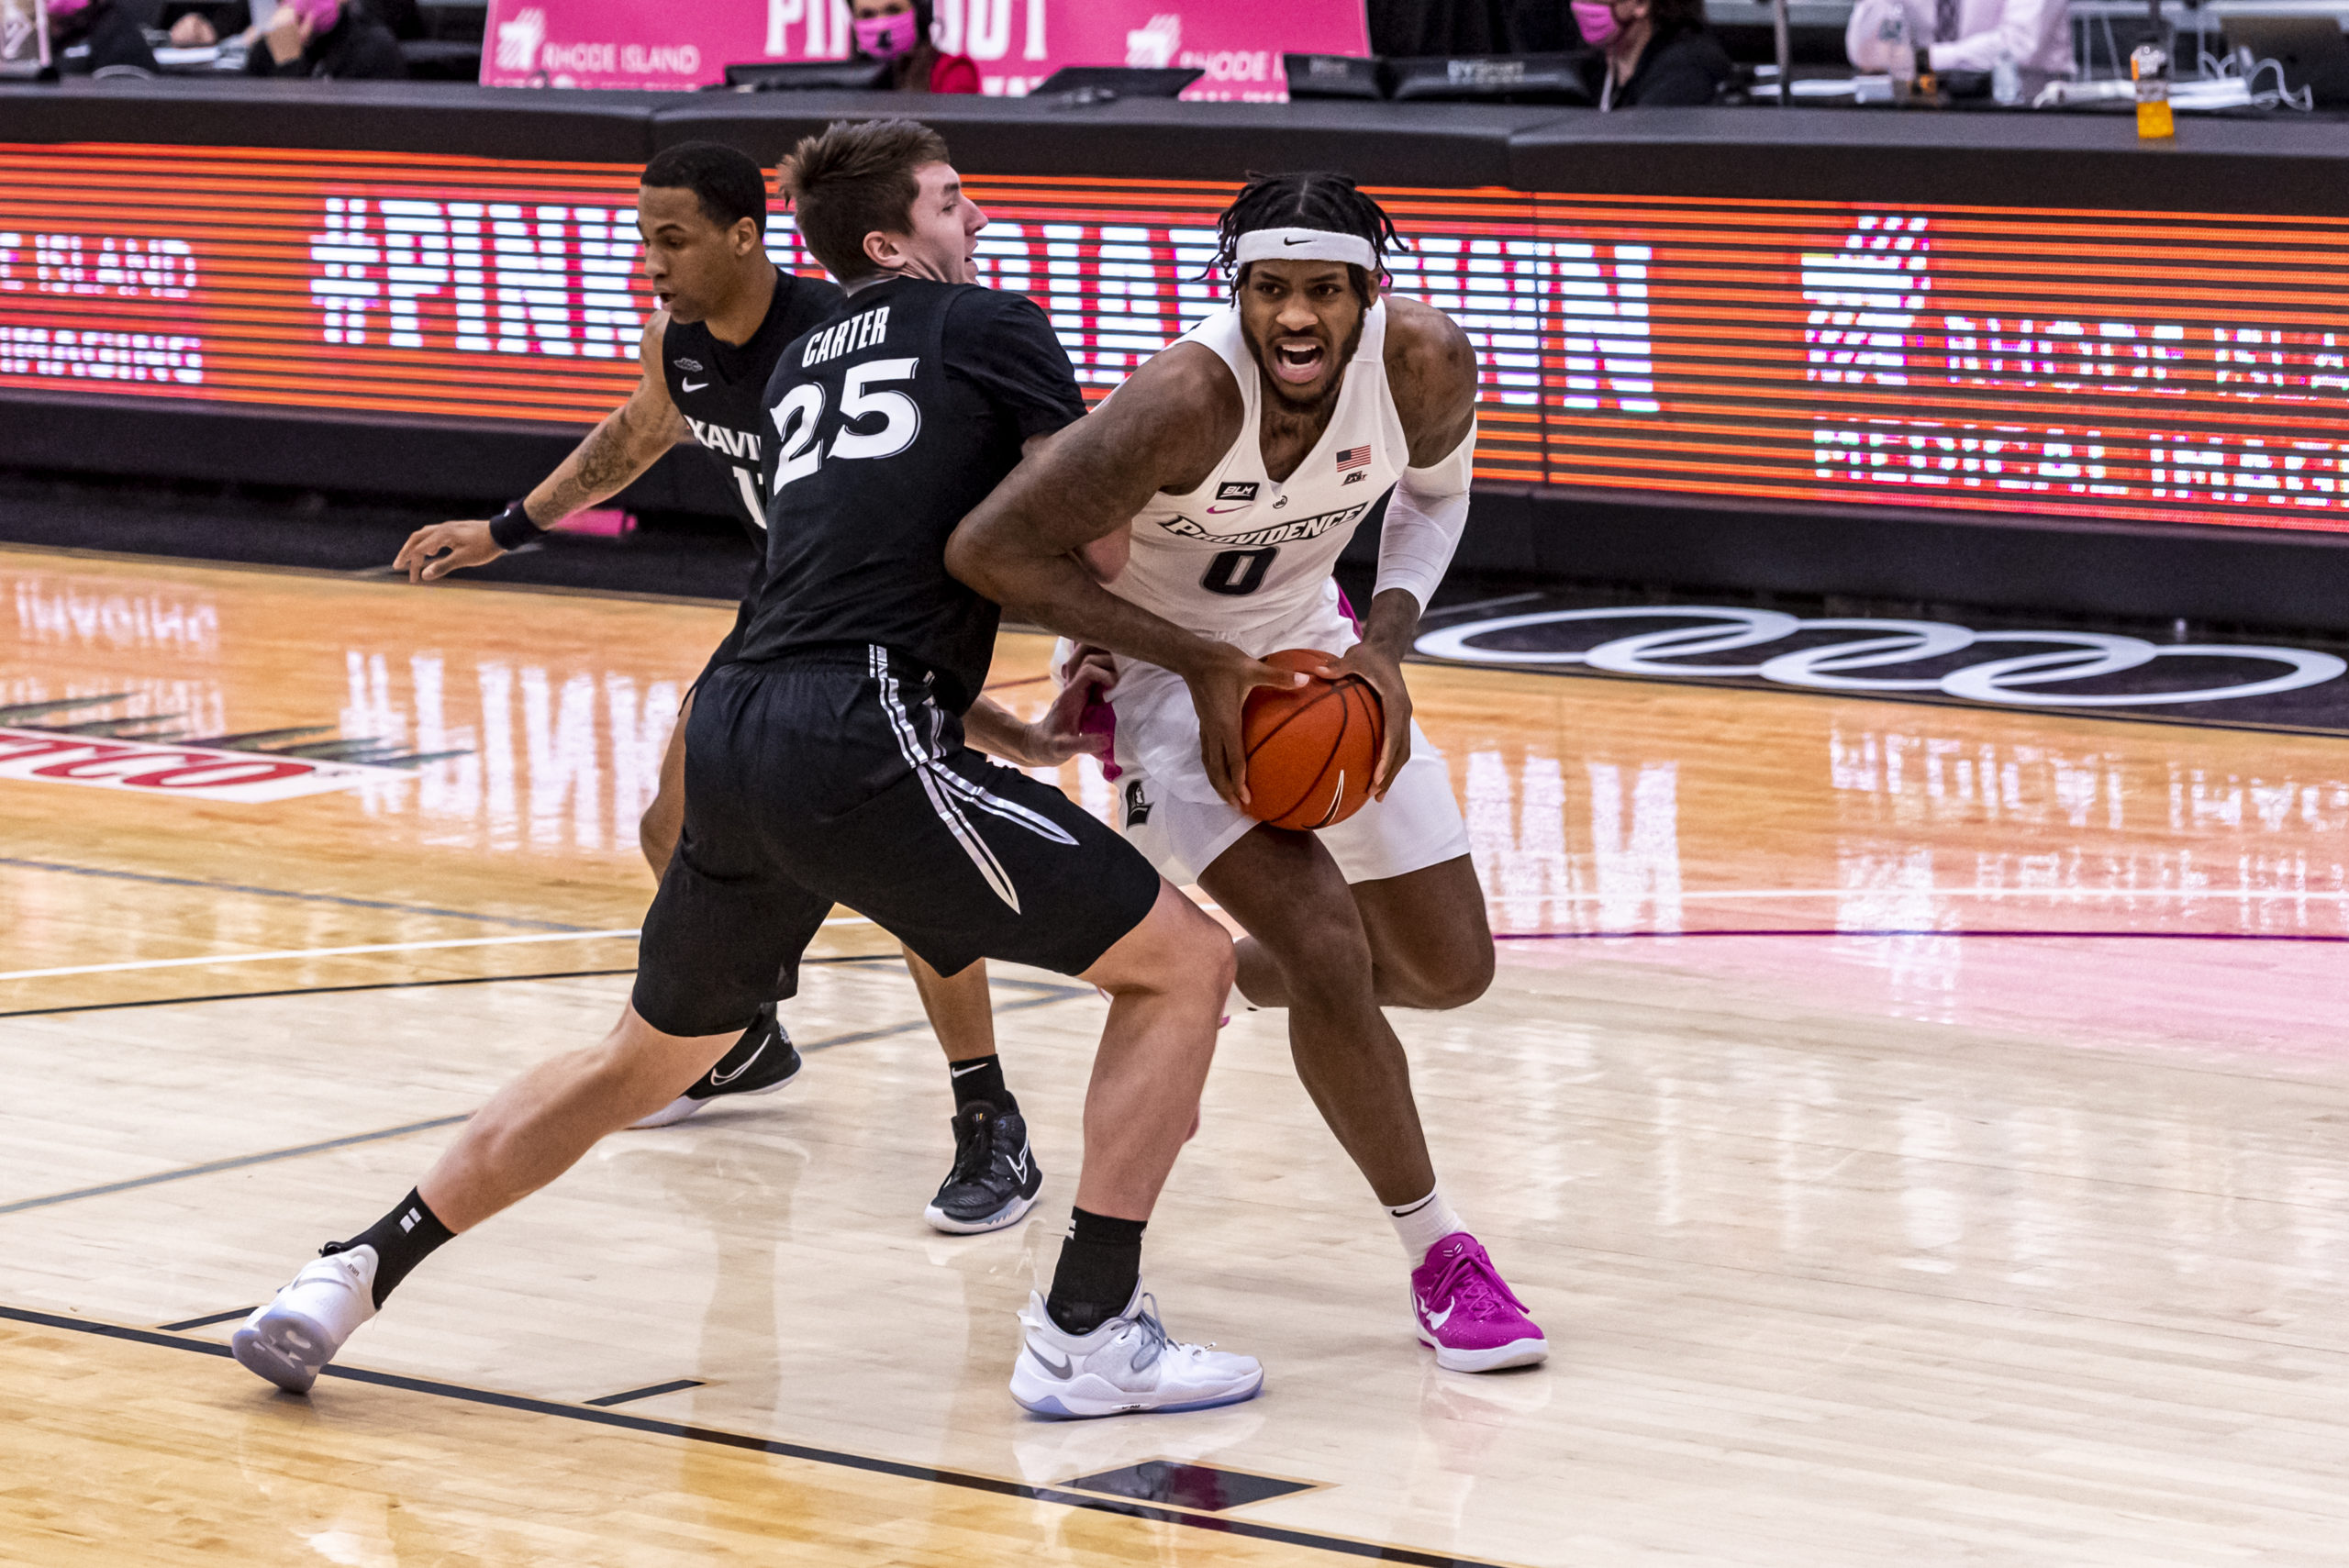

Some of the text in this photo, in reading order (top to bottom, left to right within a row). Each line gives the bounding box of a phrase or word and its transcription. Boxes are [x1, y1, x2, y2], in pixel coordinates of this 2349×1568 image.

[540, 43, 700, 74] RHODE ISLAND
[35, 233, 197, 300] ISLAND
[801, 306, 891, 369] CARTER
[1943, 315, 2187, 395] RHODE
[683, 414, 763, 462] XAVI
[769, 356, 921, 496] 25
[1813, 416, 2130, 496] MEDICAL
[1220, 483, 1254, 498] BLM
[1156, 501, 1369, 548] PROVIDENCE
[1198, 545, 1282, 596] 0
